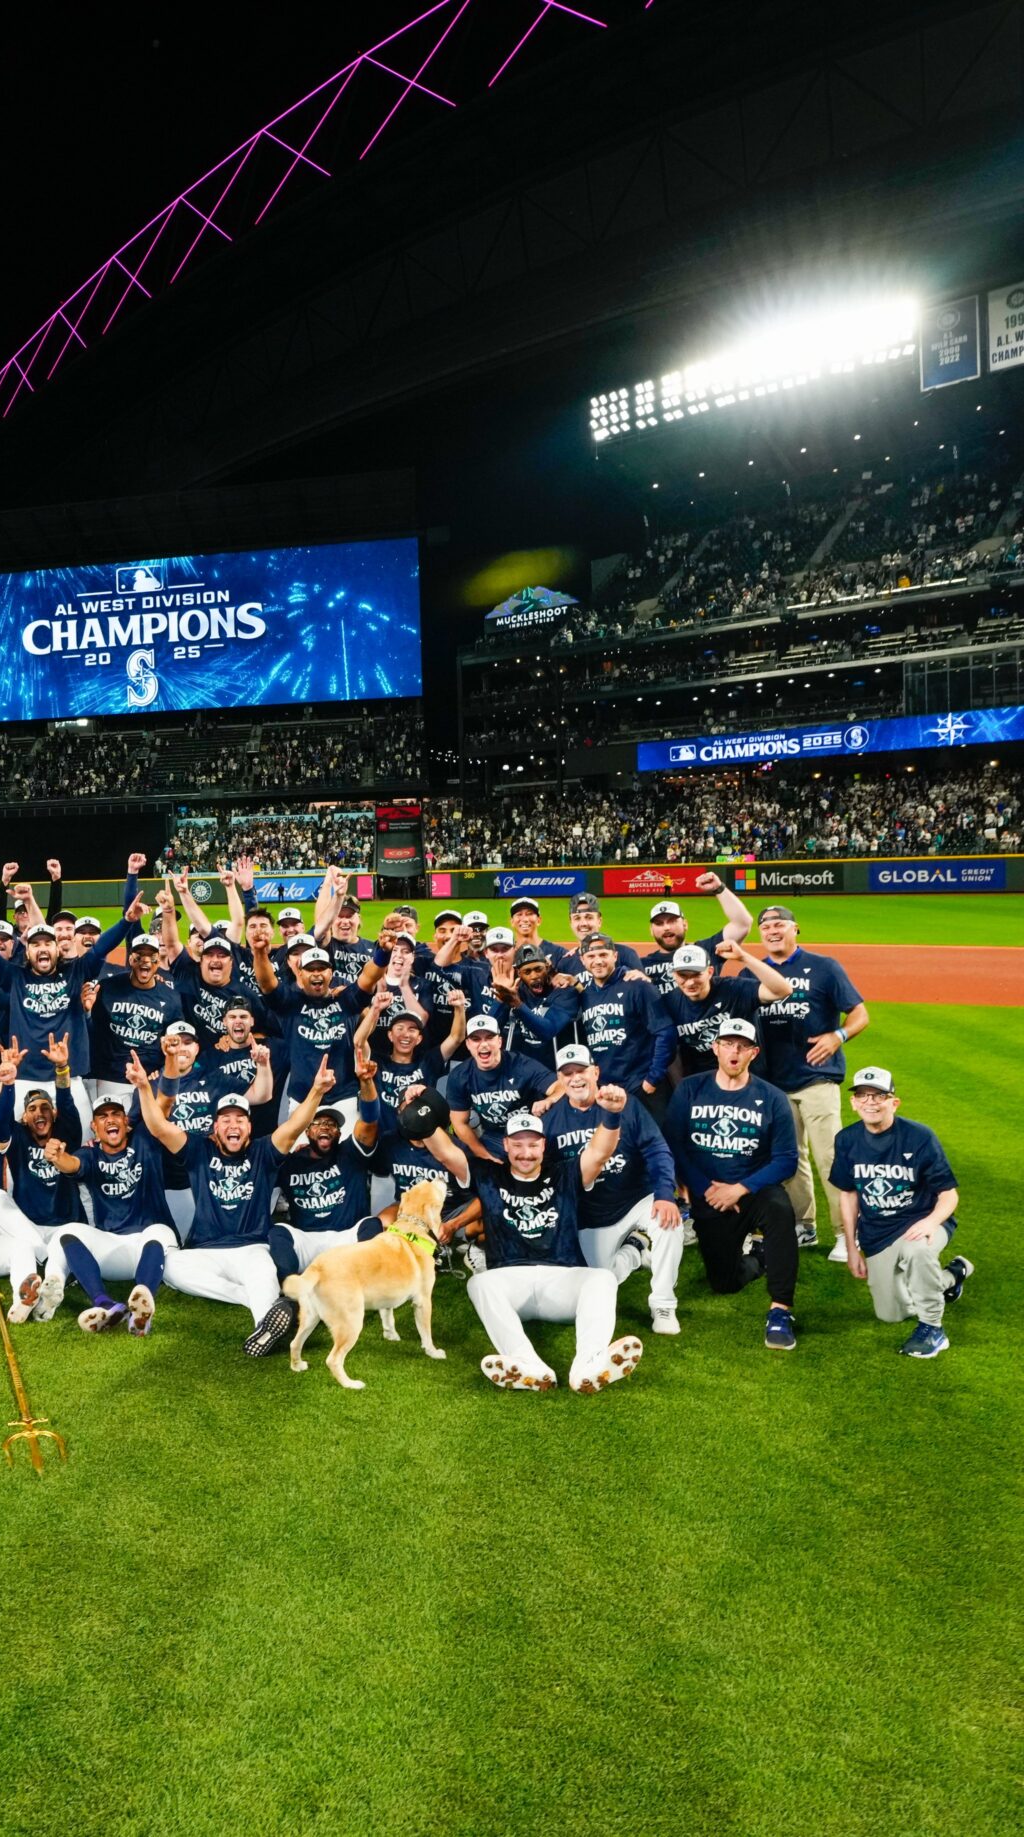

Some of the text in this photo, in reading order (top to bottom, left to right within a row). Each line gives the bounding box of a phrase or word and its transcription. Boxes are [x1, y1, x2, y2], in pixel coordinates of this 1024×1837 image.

[1005, 312, 1024, 329] 199
[992, 346, 1024, 363] CHAMP
[54, 590, 230, 616] AL WEST DIVISION
[497, 606, 568, 626] MUCKLESHOOT
[22, 602, 266, 656] CHAMPIONS
[84, 646, 201, 666] 20 25
[725, 737, 747, 745] WEST
[749, 734, 785, 743] DIVISION
[803, 735, 842, 746] 2025
[700, 738, 800, 762] CHAMPIONS
[520, 877, 575, 885] BOEING
[761, 870, 834, 885] Micrsoft
[879, 869, 956, 882] GLOBAL
[255, 883, 304, 899] Alaka
[23, 994, 70, 1012] CHAMPS
[112, 1002, 164, 1023] DIVISION
[110, 1022, 158, 1041] CHAMPS
[298, 1024, 346, 1040] CHAMPS
[677, 1012, 729, 1036] DIVISION
[691, 1105, 762, 1126] DIVISION
[691, 1132, 760, 1151] CHAMPS
[294, 1186, 346, 1209] CHAMPS
